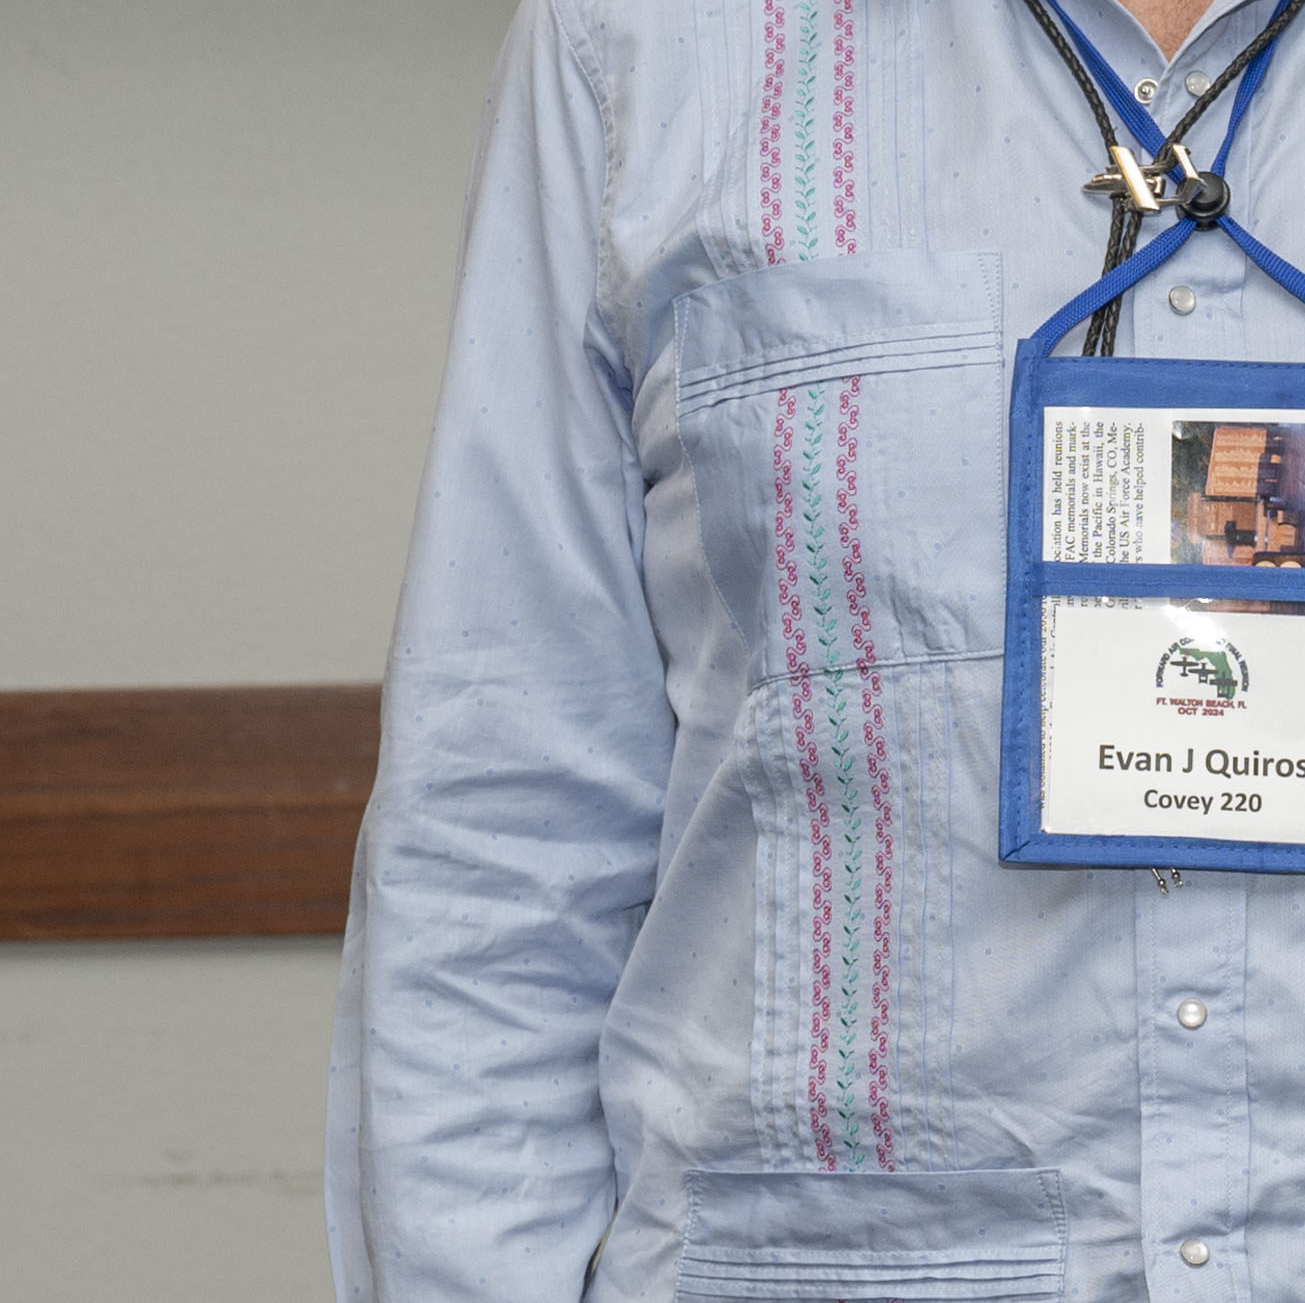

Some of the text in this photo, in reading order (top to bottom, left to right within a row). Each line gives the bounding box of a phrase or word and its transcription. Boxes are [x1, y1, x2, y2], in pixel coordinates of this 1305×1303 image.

[1080, 422, 1090, 437] the
[1053, 422, 1062, 465] reunions
[1081, 442, 1089, 450] at
[1135, 423, 1144, 463] contrib-
[1080, 455, 1089, 478] exist
[1052, 472, 1062, 493] held
[1065, 422, 1076, 560] FAC memorials and mark-
[1092, 422, 1104, 557] the Pacific in Hawaii, the
[1134, 467, 1146, 500] helped
[1081, 483, 1089, 504] now
[1052, 499, 1062, 515] has
[1120, 511, 1129, 526] Air
[1120, 532, 1129, 547] US
[1133, 531, 1143, 553] who
[1120, 551, 1129, 563] he
[1169, 698, 1203, 706] WALTON
[1202, 708, 1224, 716] 2024
[1098, 744, 1173, 772] Evan
[1182, 748, 1193, 775] J
[1143, 788, 1262, 816] Covey 220
